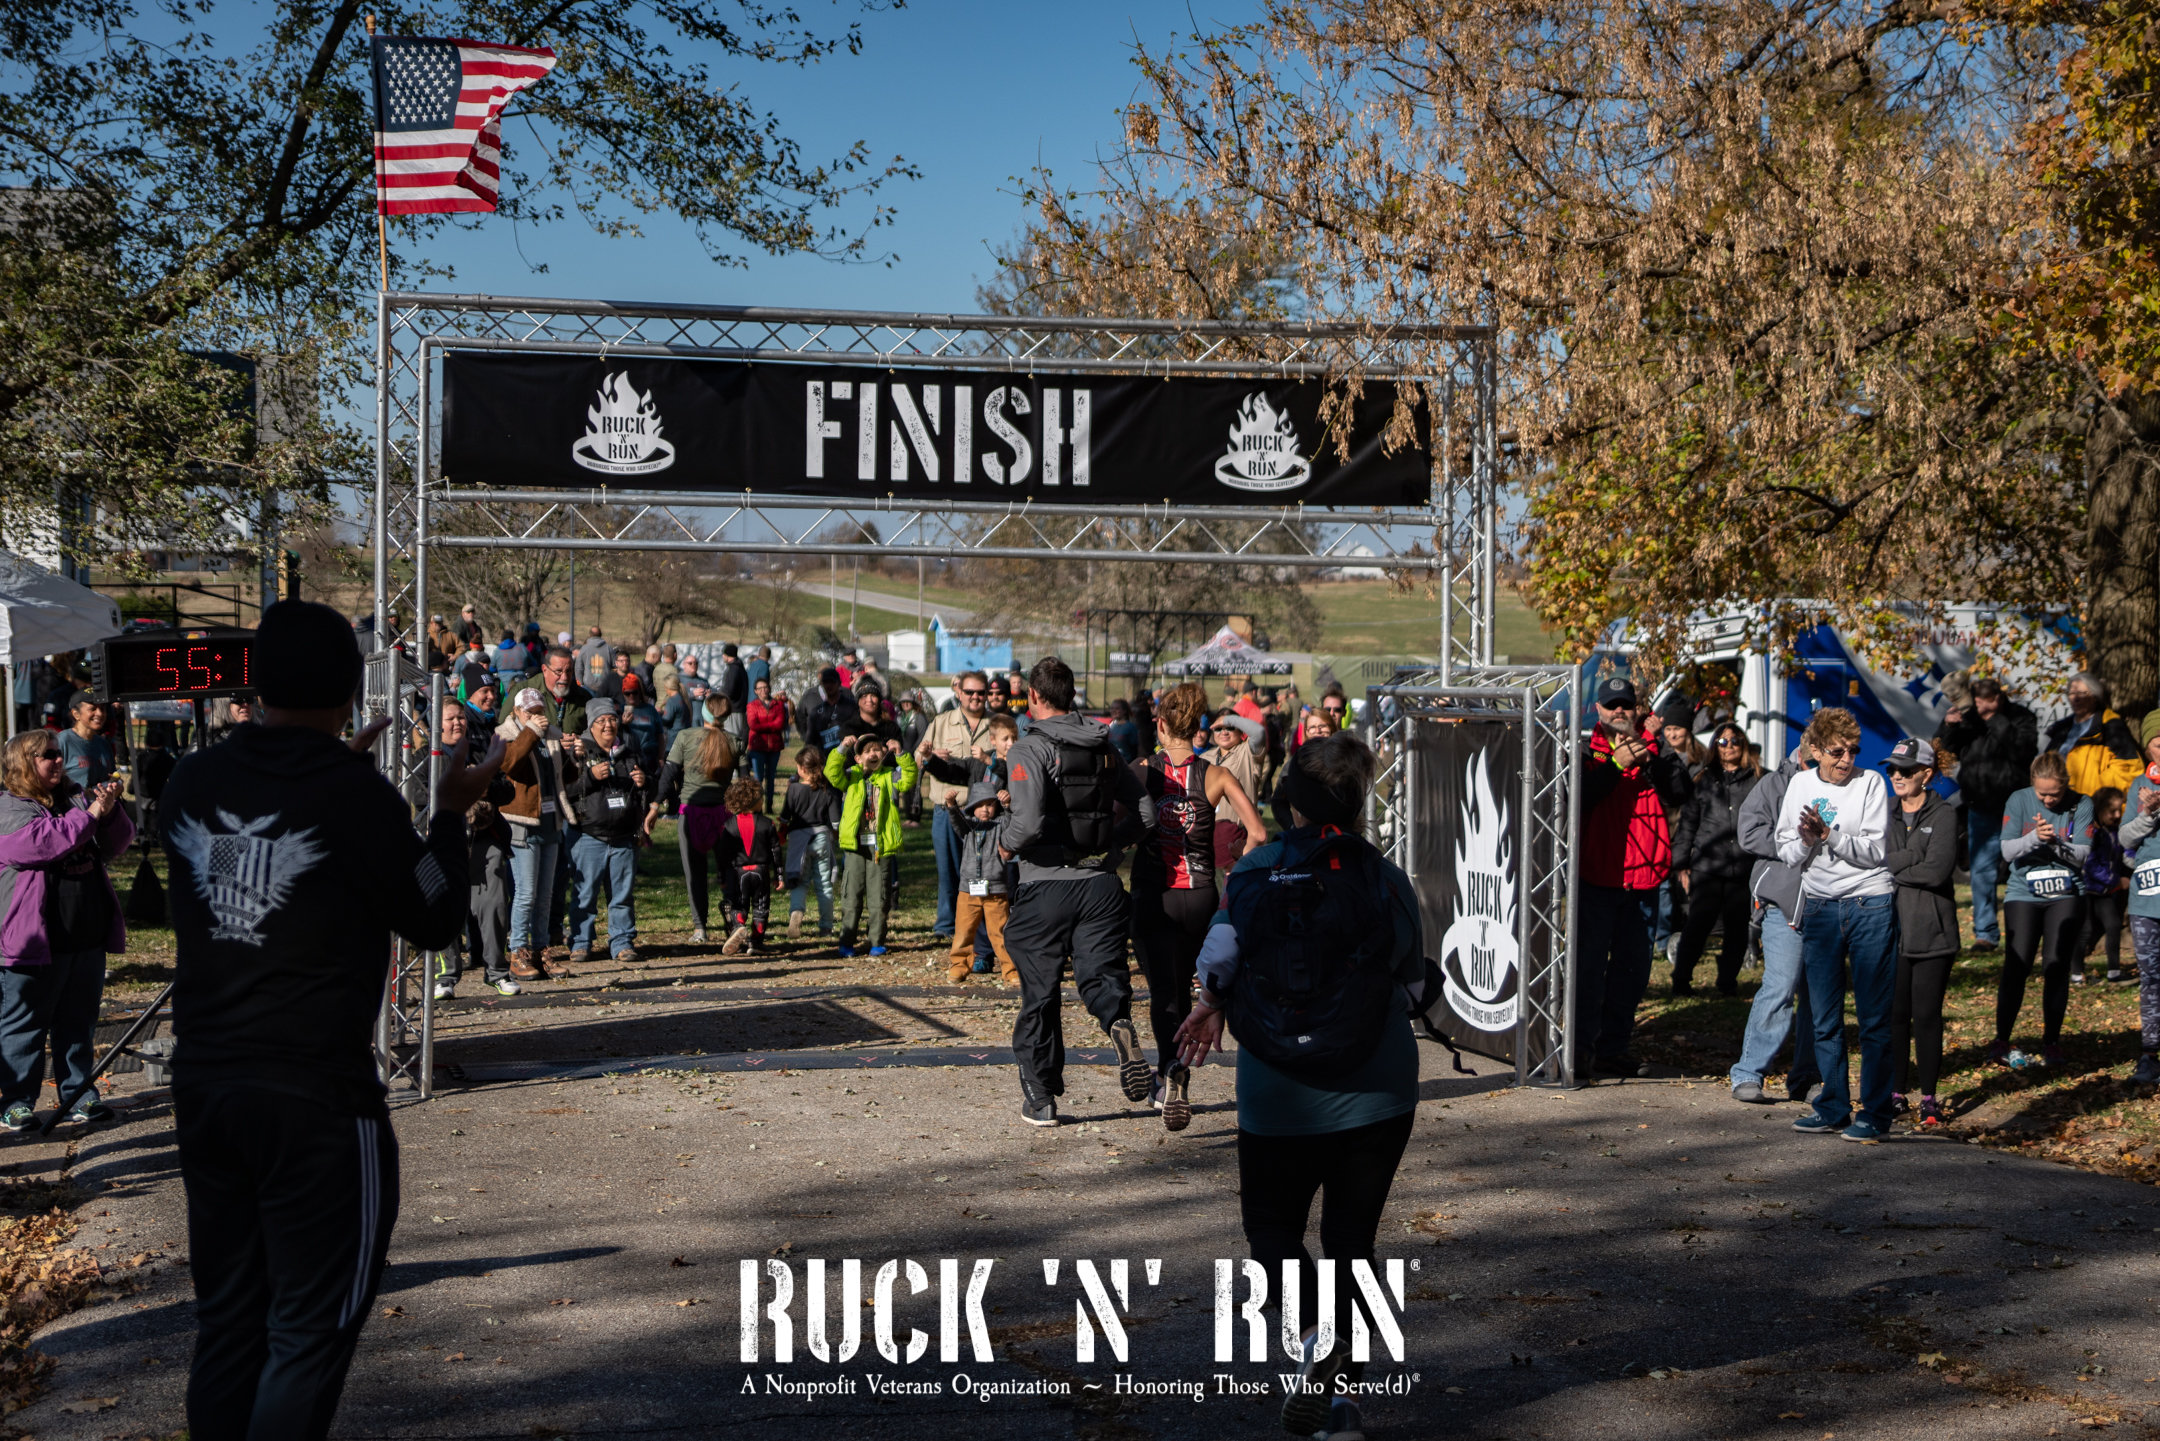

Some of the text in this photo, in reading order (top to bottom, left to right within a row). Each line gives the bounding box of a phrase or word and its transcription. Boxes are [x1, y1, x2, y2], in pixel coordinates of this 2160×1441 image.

[602, 416, 645, 434] RUCK
[806, 381, 1091, 487] FINISH
[1242, 434, 1283, 452] RUCK
[2033, 878, 2065, 895] 908
[1467, 870, 1503, 924] RUCK
